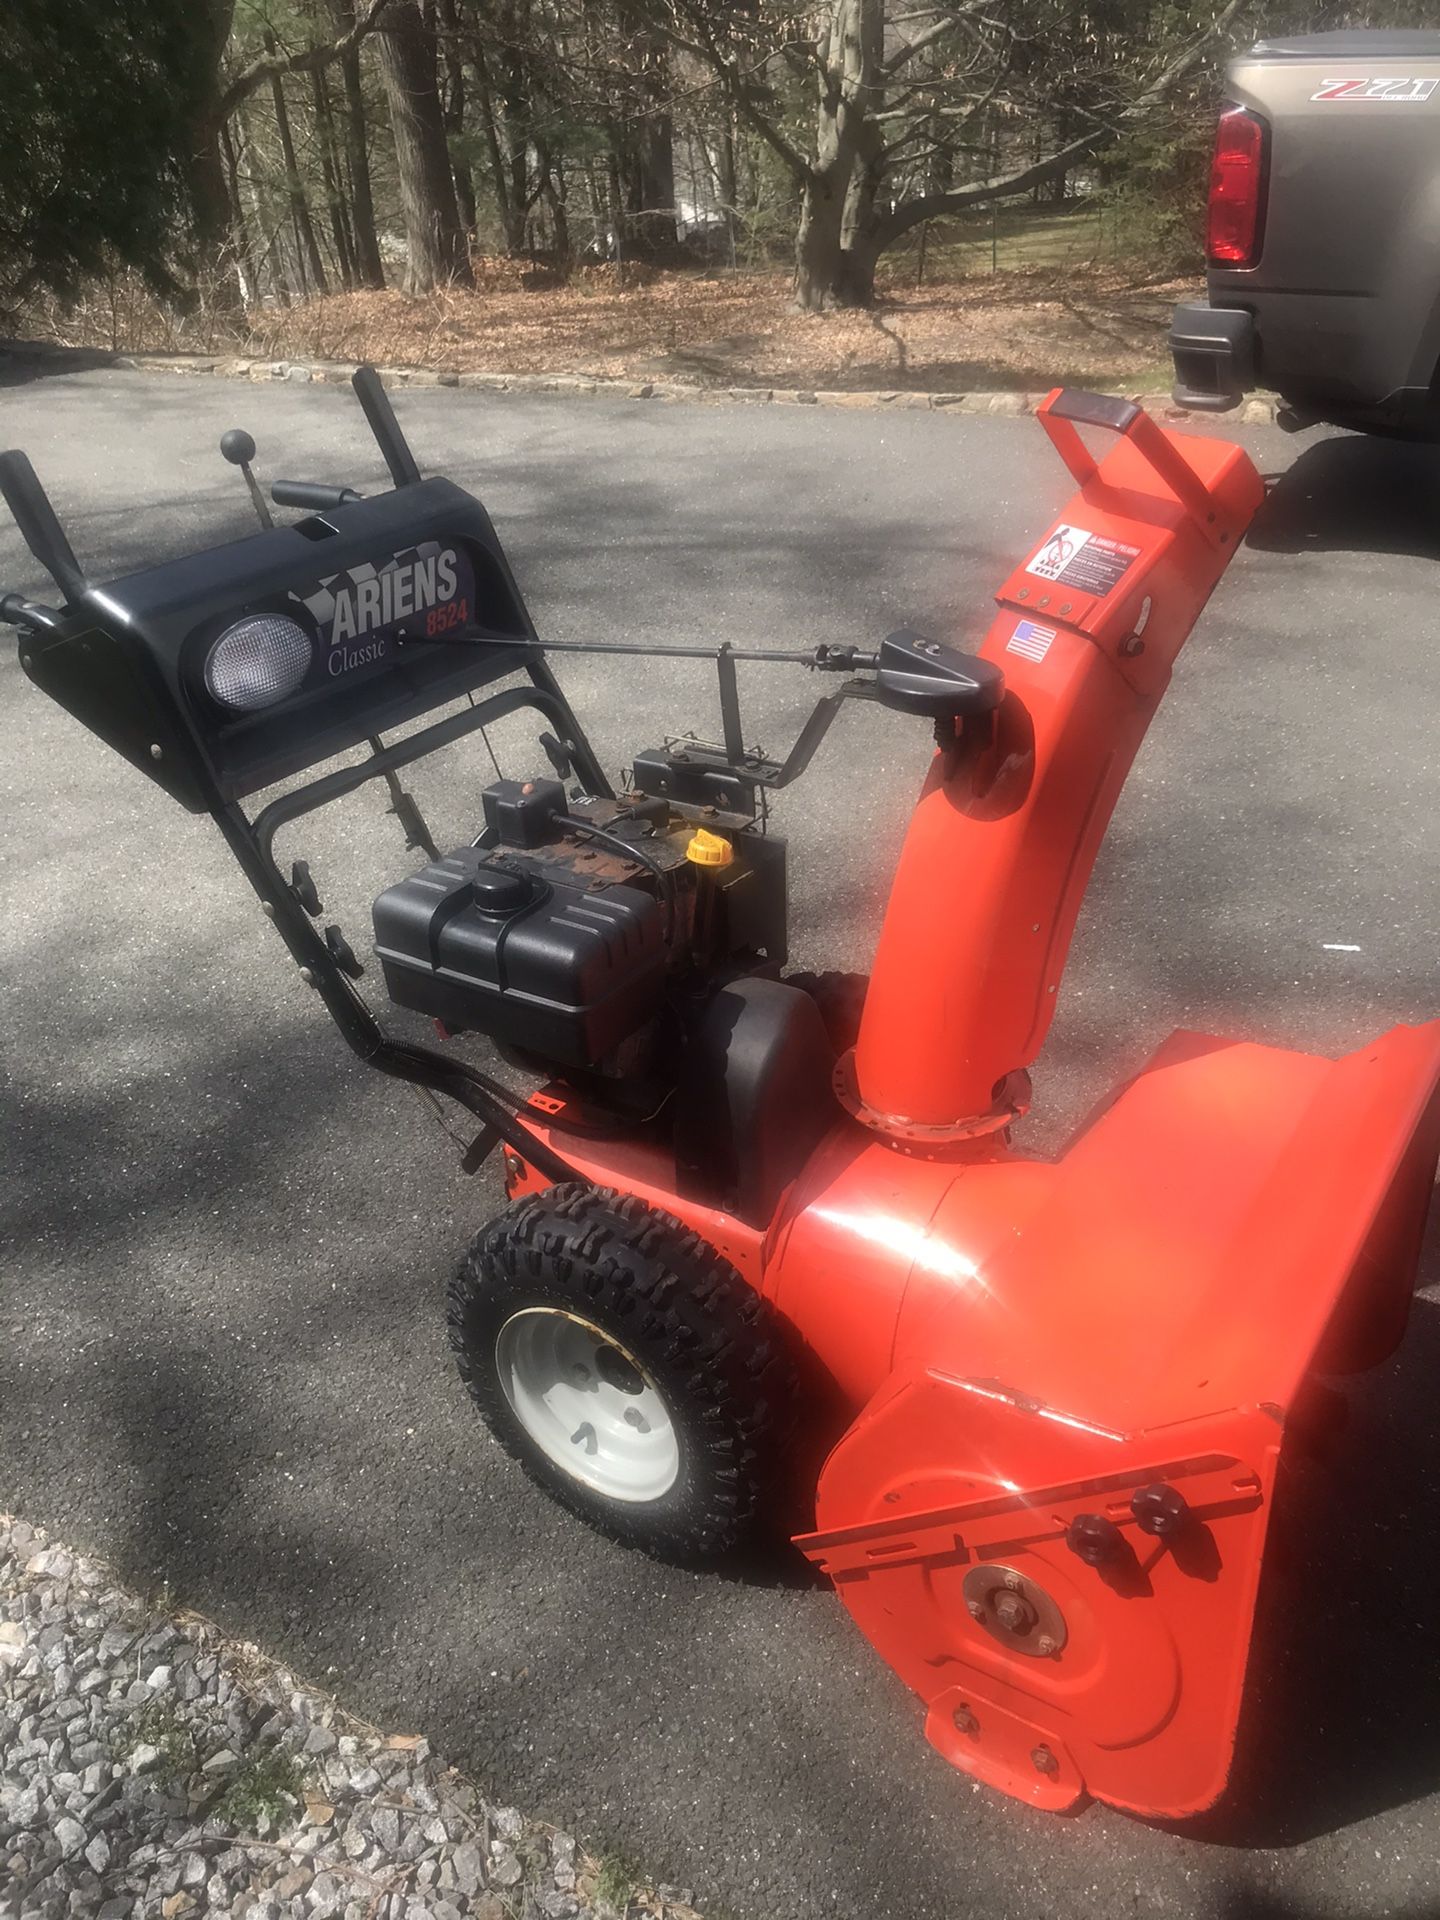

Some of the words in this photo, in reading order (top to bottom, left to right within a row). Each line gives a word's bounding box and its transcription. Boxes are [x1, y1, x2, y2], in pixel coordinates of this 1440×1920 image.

[1310, 78, 1440, 101] Z71
[331, 550, 457, 645] ARIENS
[426, 601, 469, 636] 8524
[328, 635, 386, 677] Classic
